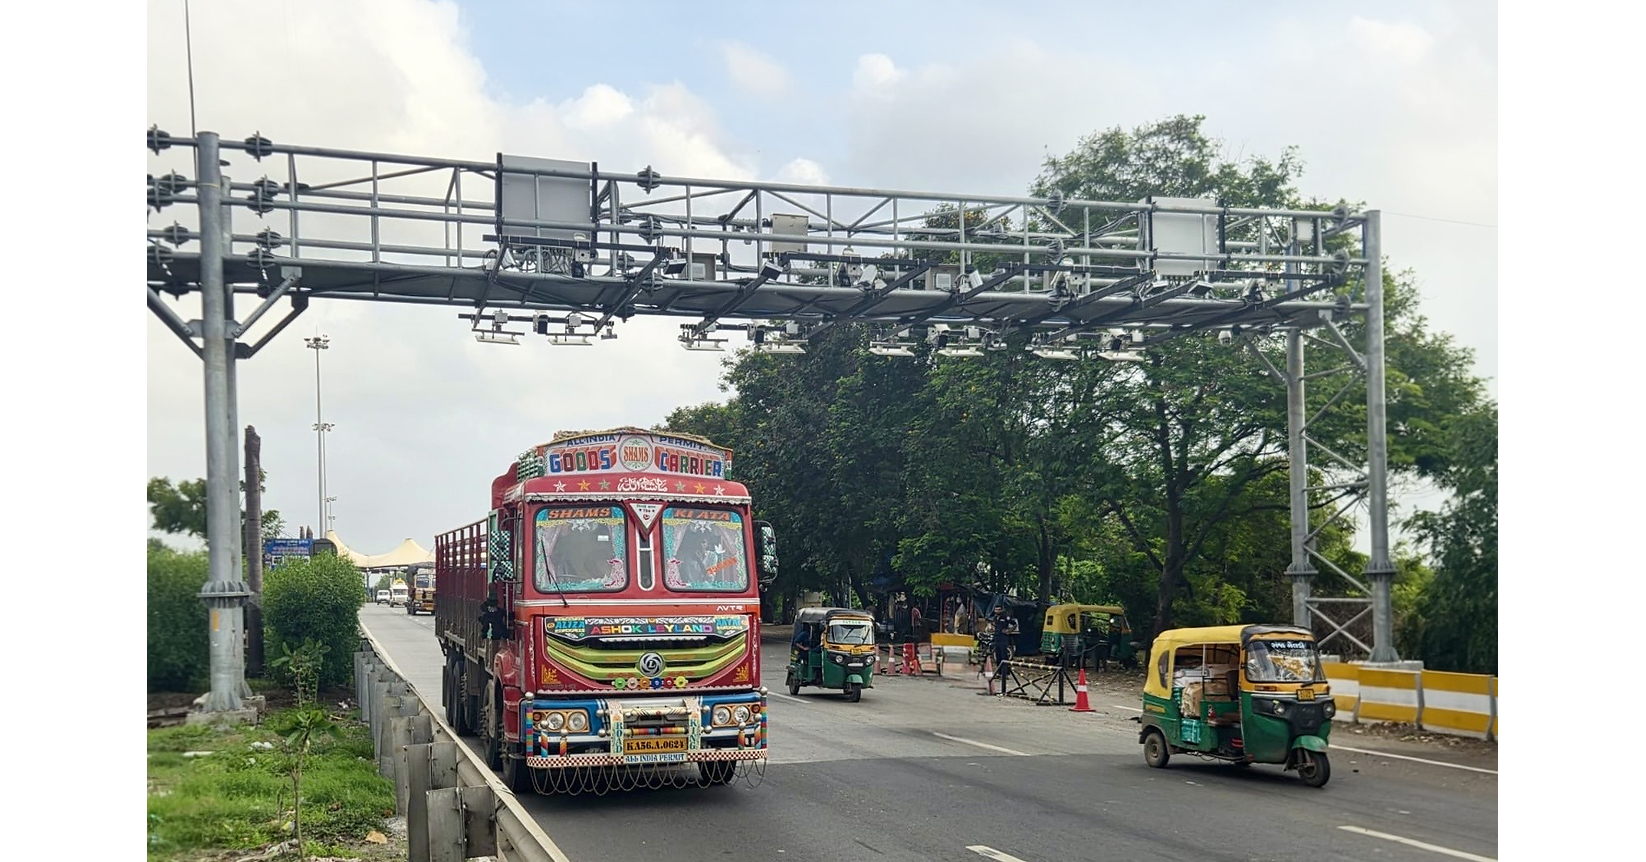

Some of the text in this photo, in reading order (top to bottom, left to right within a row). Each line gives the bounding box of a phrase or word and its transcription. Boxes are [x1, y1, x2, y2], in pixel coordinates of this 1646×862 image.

[623, 446, 649, 462] SHAMS
[549, 449, 722, 477] GOODS CARRIER
[548, 507, 611, 519] SHAMS
[555, 620, 585, 629] ALIZA
[590, 624, 713, 634] ASHOK LEYLAND
[689, 718, 698, 750] KING
[640, 754, 658, 762] INDIA
[660, 753, 685, 761] PERMIT
